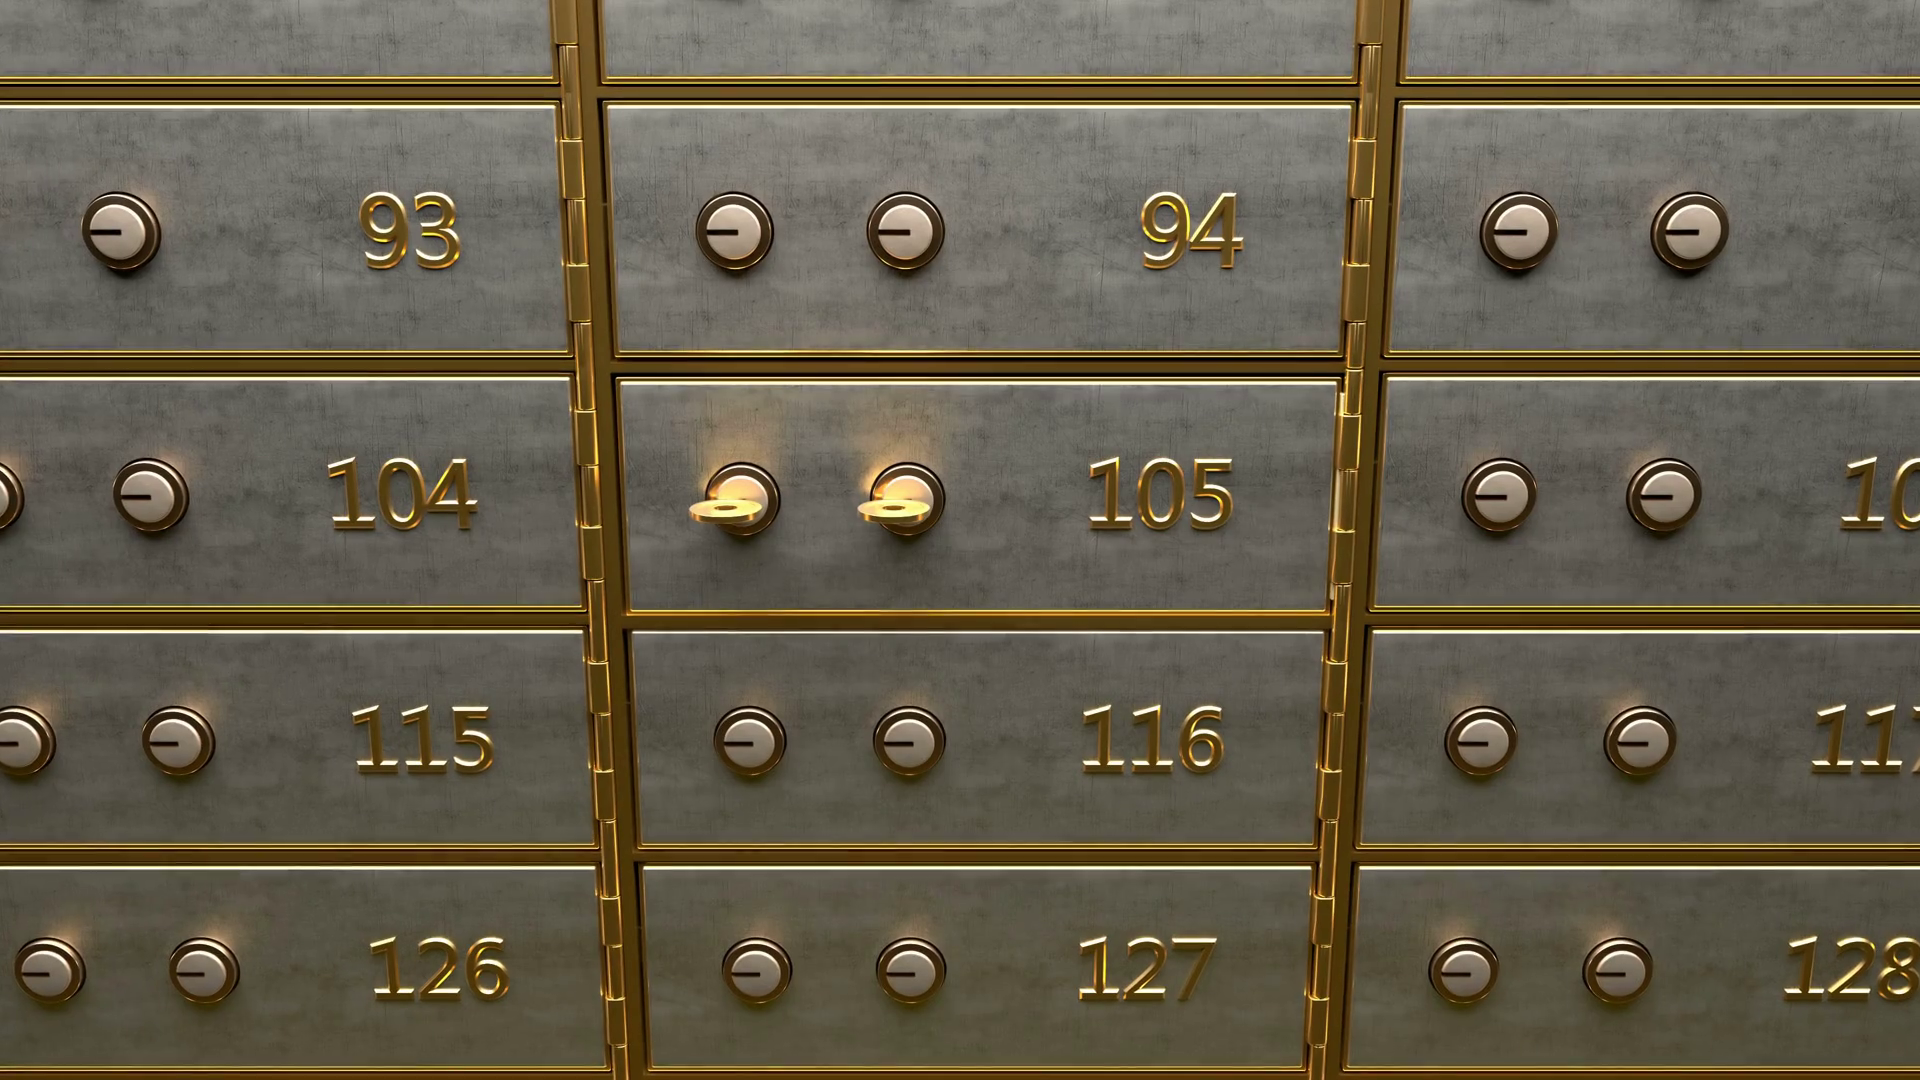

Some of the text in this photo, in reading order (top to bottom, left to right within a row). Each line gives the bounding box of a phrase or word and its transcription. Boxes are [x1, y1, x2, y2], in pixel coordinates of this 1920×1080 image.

[359, 191, 461, 269] 93
[1141, 191, 1244, 270] 94
[327, 456, 478, 530] 104
[1089, 456, 1234, 531] 105
[351, 704, 494, 774] 115
[1082, 704, 1225, 774] 116
[1811, 704, 1920, 774] 11
[369, 936, 510, 1001] 126
[1079, 936, 1218, 1002] 127
[1783, 935, 1920, 1001] 128
